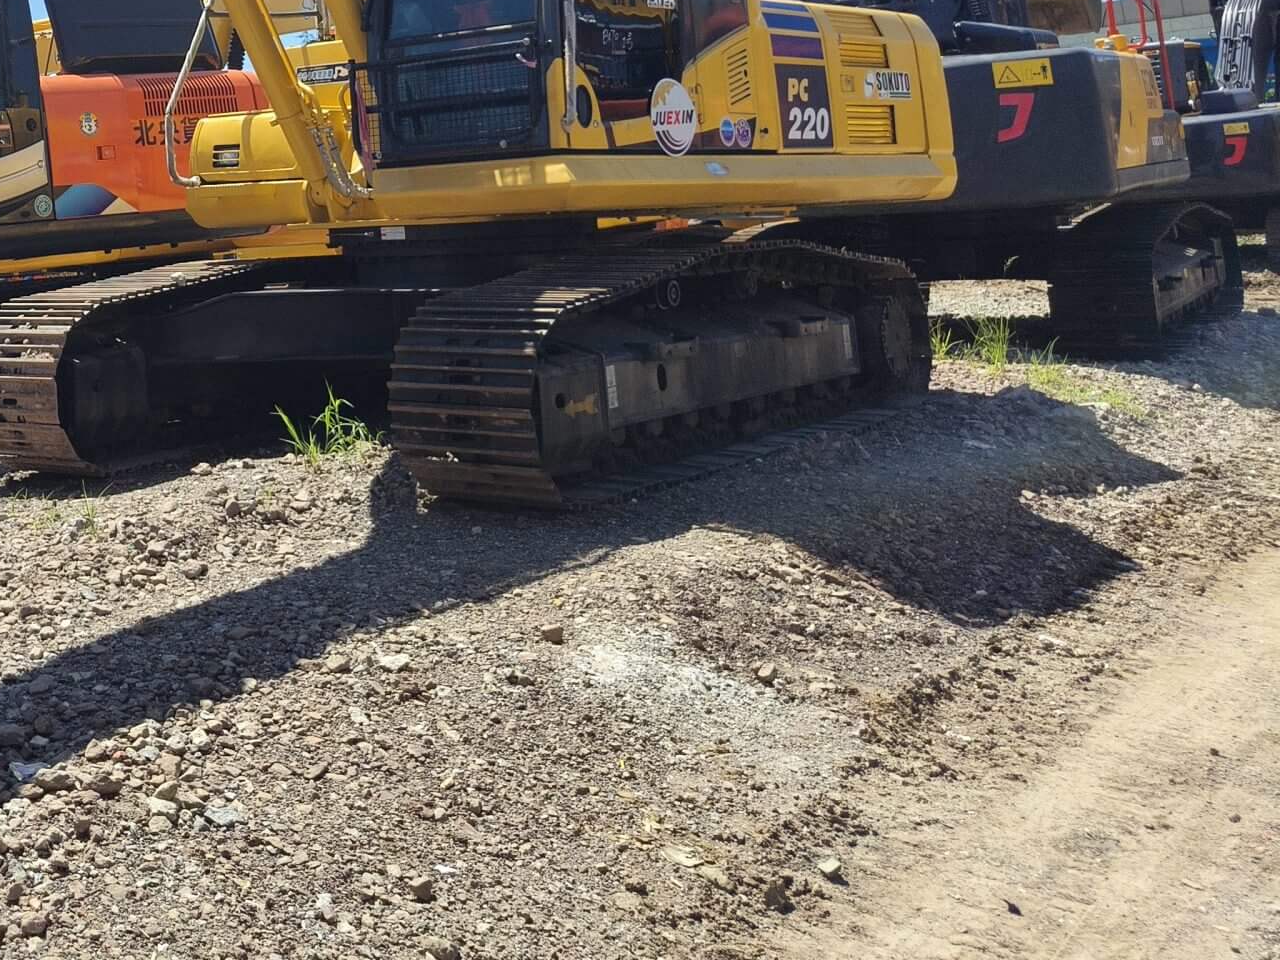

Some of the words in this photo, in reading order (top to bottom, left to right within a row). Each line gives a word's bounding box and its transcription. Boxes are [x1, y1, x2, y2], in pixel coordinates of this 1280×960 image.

[787, 77, 809, 102] PC
[875, 72, 910, 91] SOKUTO
[652, 109, 694, 127] JUEXIN
[787, 106, 829, 140] 220
